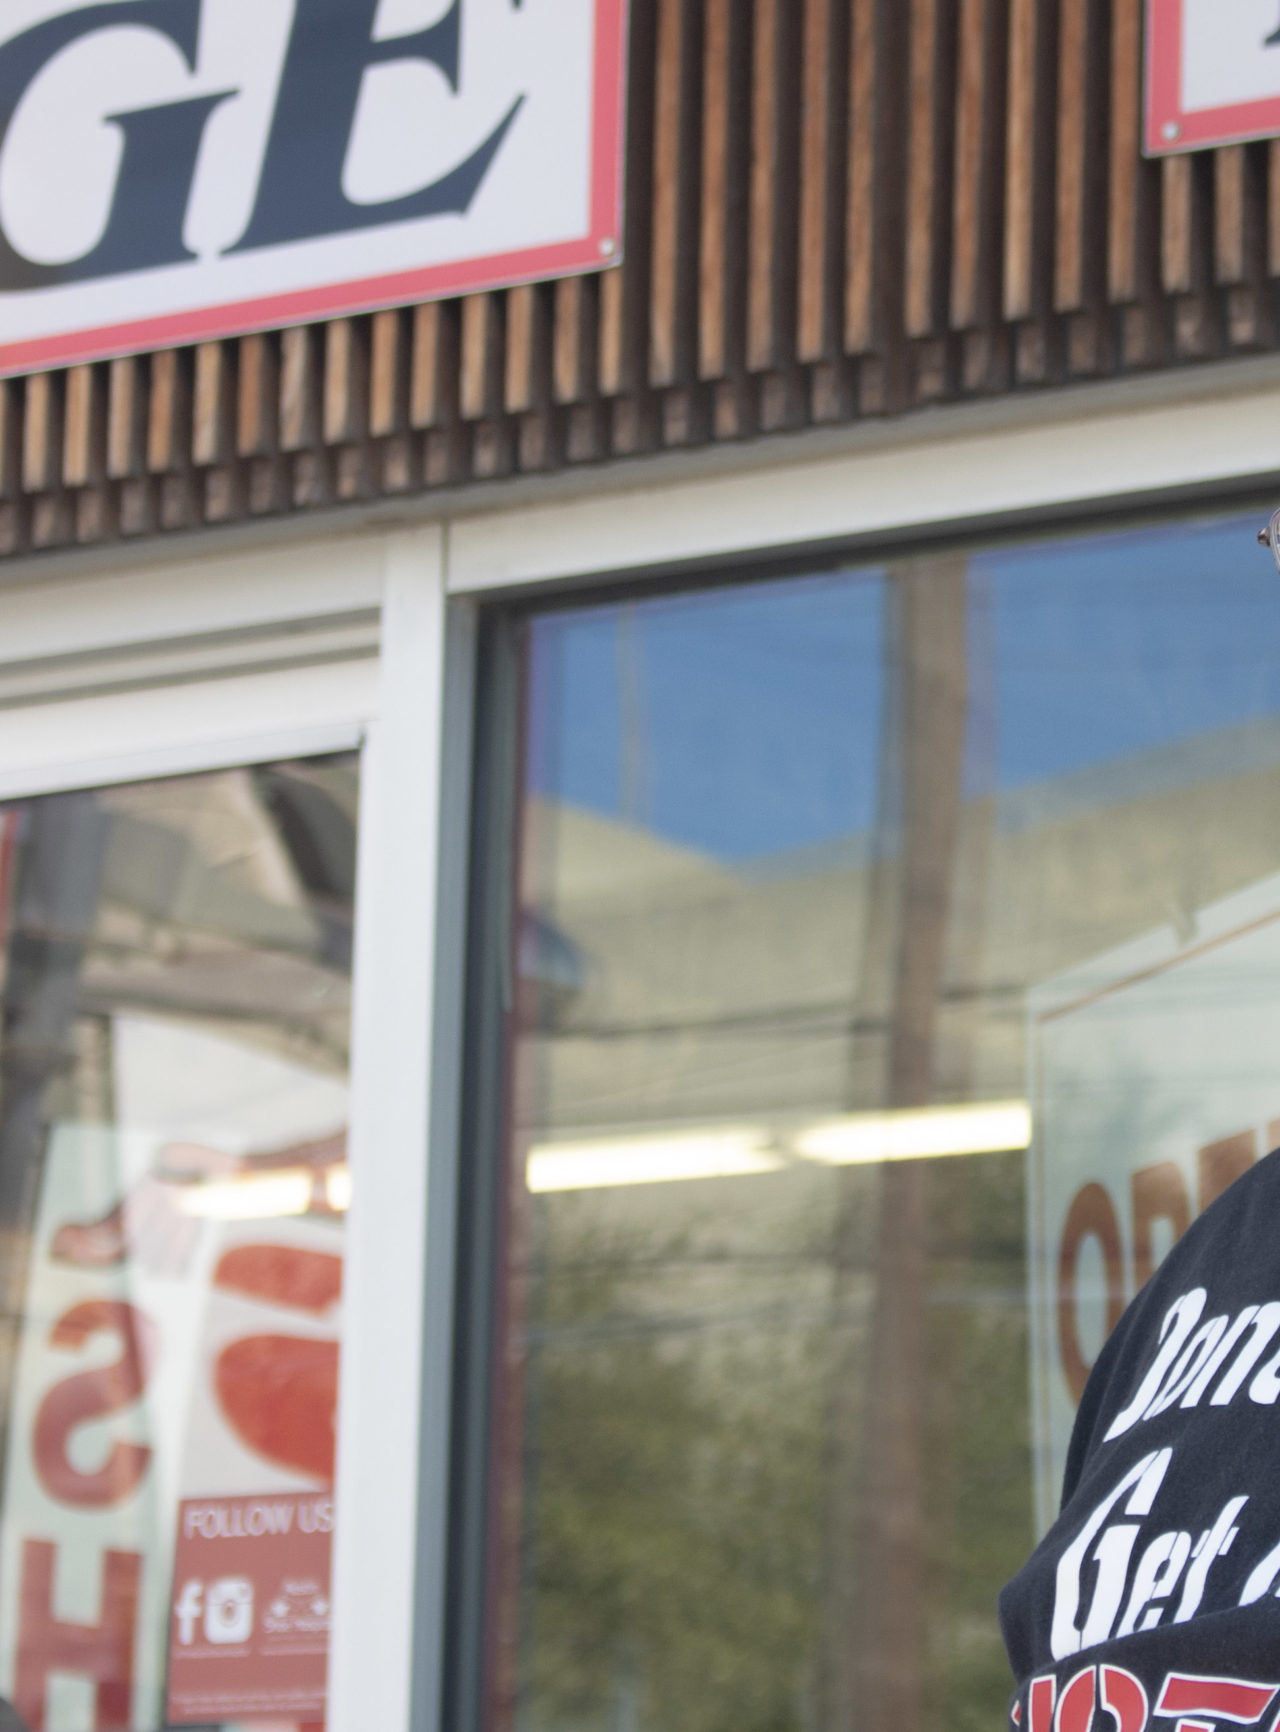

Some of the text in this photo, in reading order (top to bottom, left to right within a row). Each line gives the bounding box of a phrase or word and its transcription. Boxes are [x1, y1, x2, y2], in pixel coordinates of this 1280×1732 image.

[184, 1502, 333, 1539] FOLLOW US
[1050, 1447, 1250, 1663] Get
